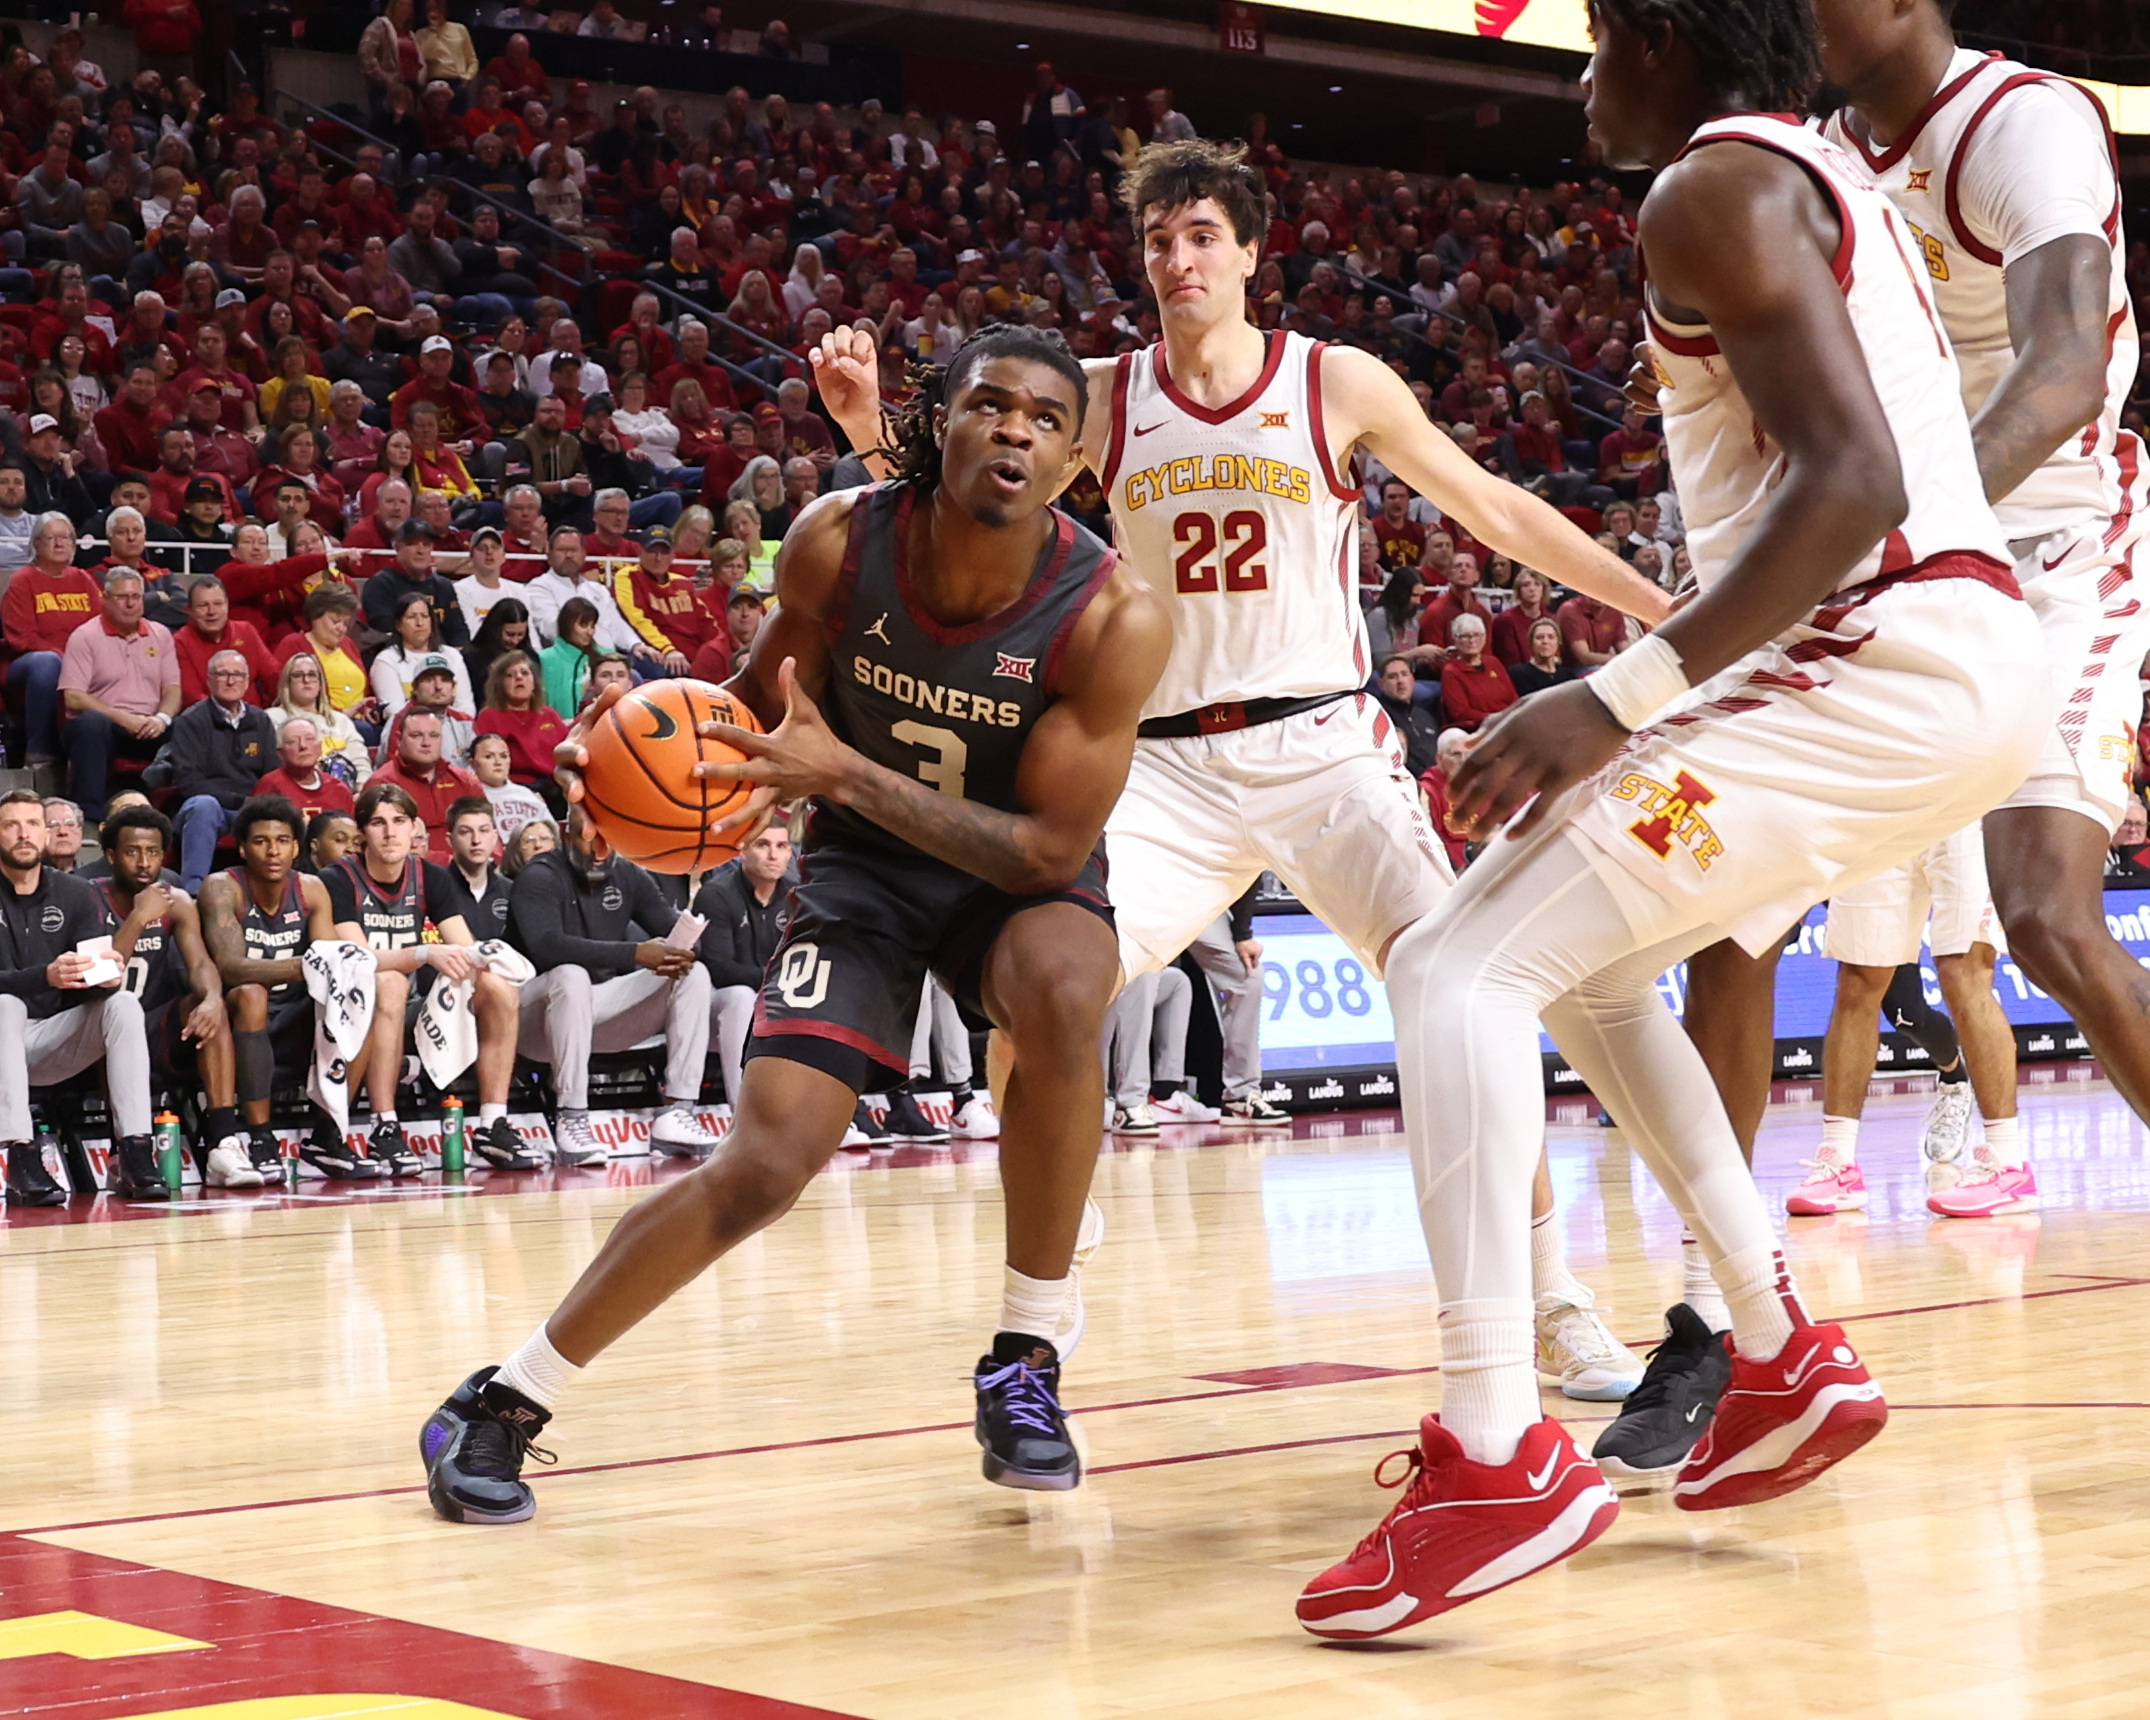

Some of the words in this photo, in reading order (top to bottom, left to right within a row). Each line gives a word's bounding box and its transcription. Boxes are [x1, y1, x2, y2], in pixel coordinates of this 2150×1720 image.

[1228, 28, 1257, 51] 113
[1259, 411, 1290, 429] XII
[1125, 454, 1311, 511] CYCLONES
[1173, 510, 1268, 594] 22
[995, 653, 1034, 682] XII
[854, 655, 1021, 728] SOONERS
[891, 718, 968, 799] 3
[1609, 772, 1725, 872] STATE
[363, 912, 415, 929] SOONERS
[245, 927, 302, 947] SOONERS
[777, 942, 832, 1008] OU
[1263, 957, 1371, 1021] 988
[1262, 1088, 1293, 1102] ANDUS
[1308, 1085, 1344, 1100] LANDUS
[1360, 1081, 1395, 1096] LANDUS
